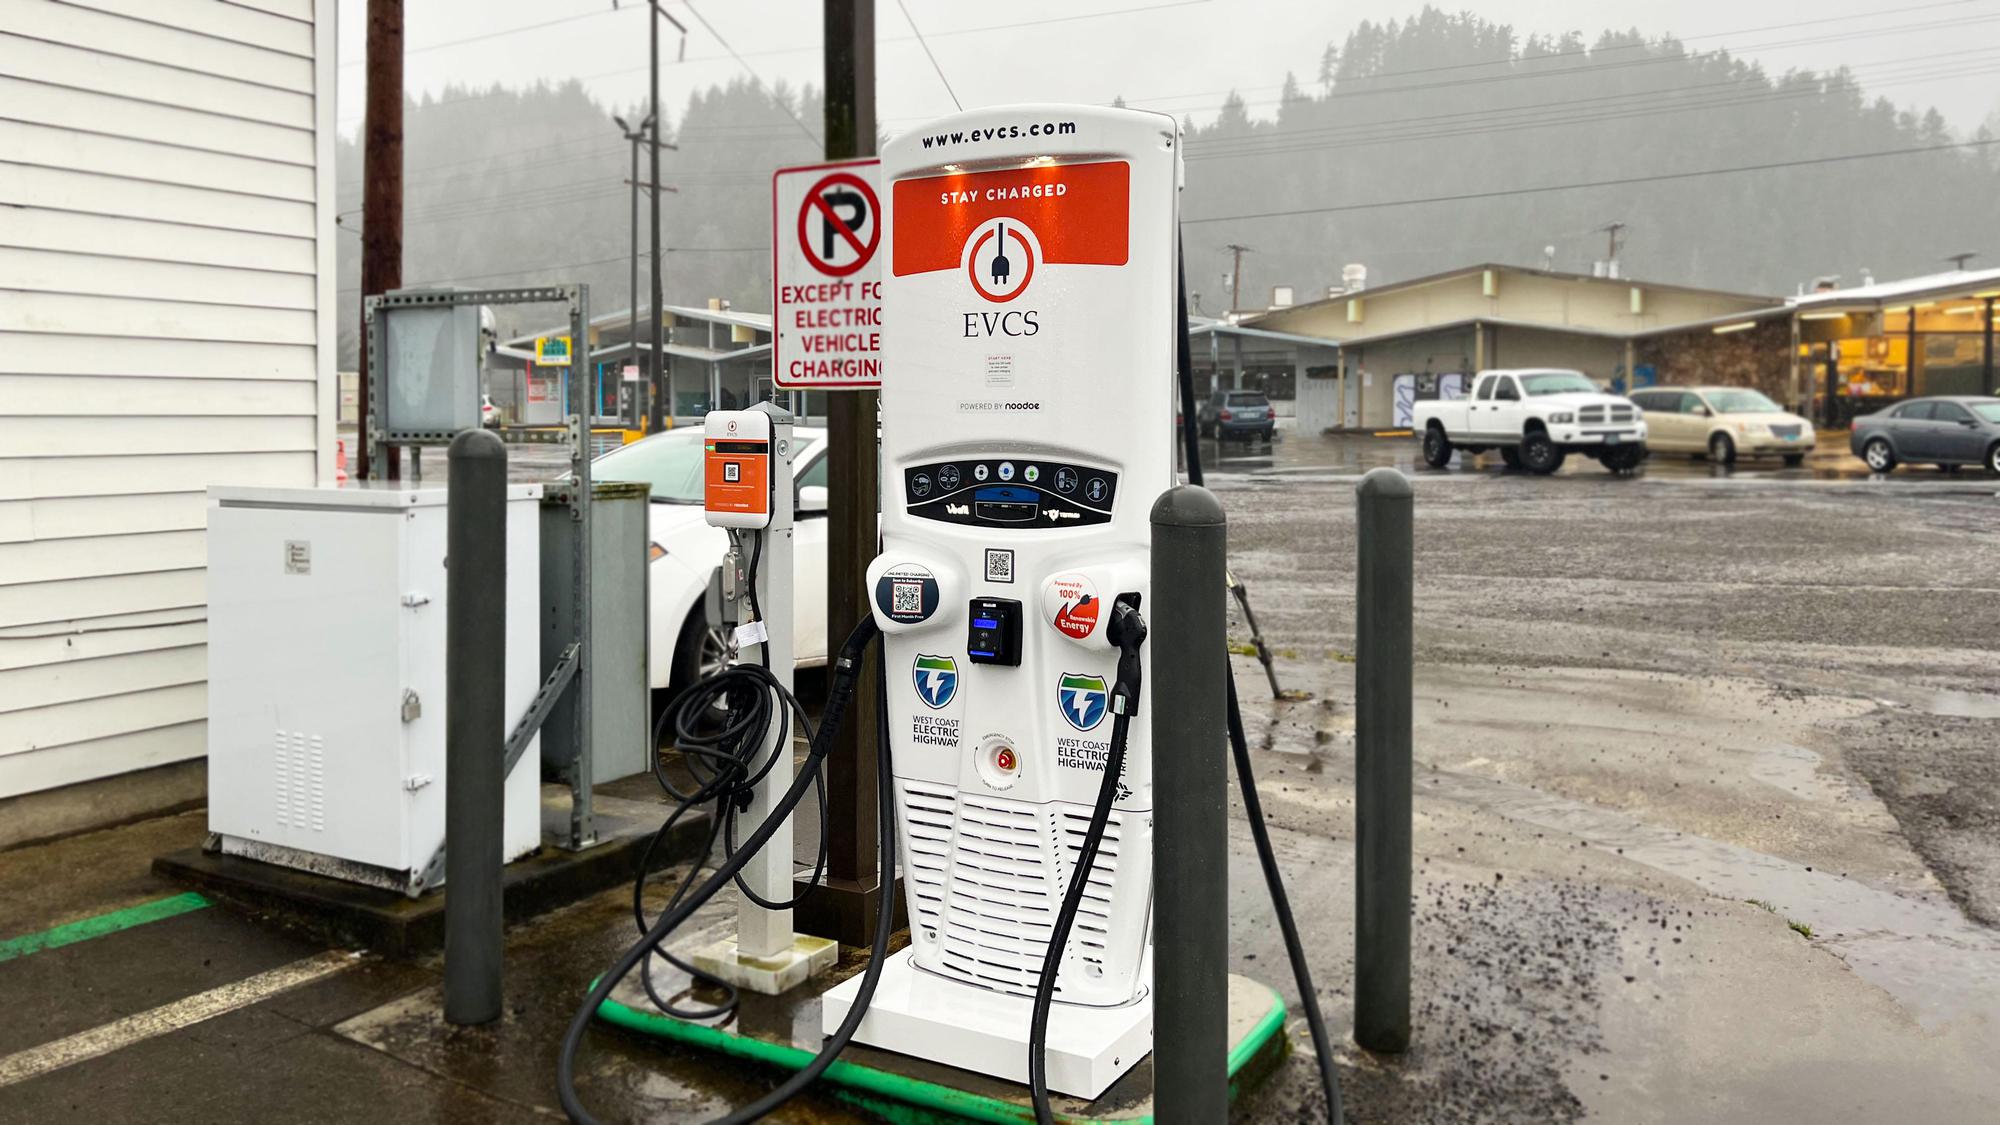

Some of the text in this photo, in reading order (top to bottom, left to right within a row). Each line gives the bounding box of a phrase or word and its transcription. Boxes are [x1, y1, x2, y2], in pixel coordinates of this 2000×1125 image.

[922, 120, 1076, 149] www.evcs.com
[941, 183, 1067, 205] STAY CHARGED
[781, 282, 854, 304] EXCEPT
[963, 310, 1040, 338] EVCS
[801, 332, 880, 353] VEHICLE
[789, 358, 881, 379] CHARGIN
[960, 402, 993, 410] POWERED
[994, 402, 1003, 410] BY
[1059, 589, 1081, 600] 100%
[1060, 618, 1090, 634] Energy
[912, 714, 960, 728] WEST COAST
[913, 723, 959, 738] ELECTRIC
[913, 733, 959, 748] HIGHWAY
[1057, 737, 1110, 751] WEST COAST
